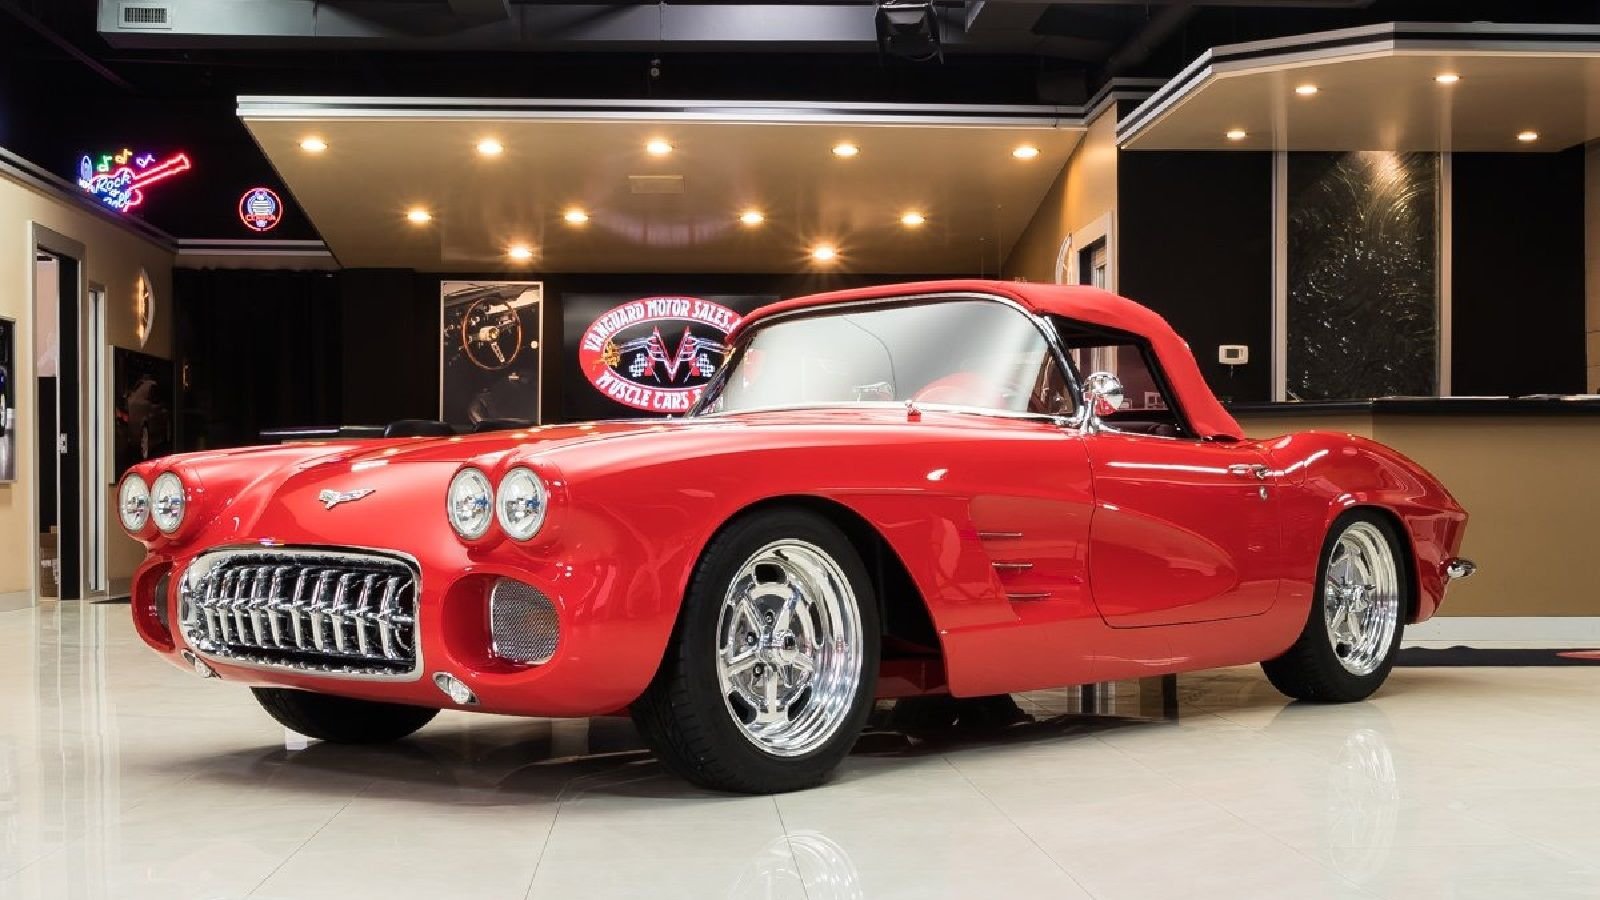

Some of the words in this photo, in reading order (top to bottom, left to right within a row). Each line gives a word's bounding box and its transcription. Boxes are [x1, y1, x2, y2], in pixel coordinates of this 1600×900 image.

[584, 303, 645, 350] VANGUARD
[645, 299, 690, 317] MOTOR
[596, 372, 650, 407] MUSCLE
[654, 391, 690, 409] CARS
